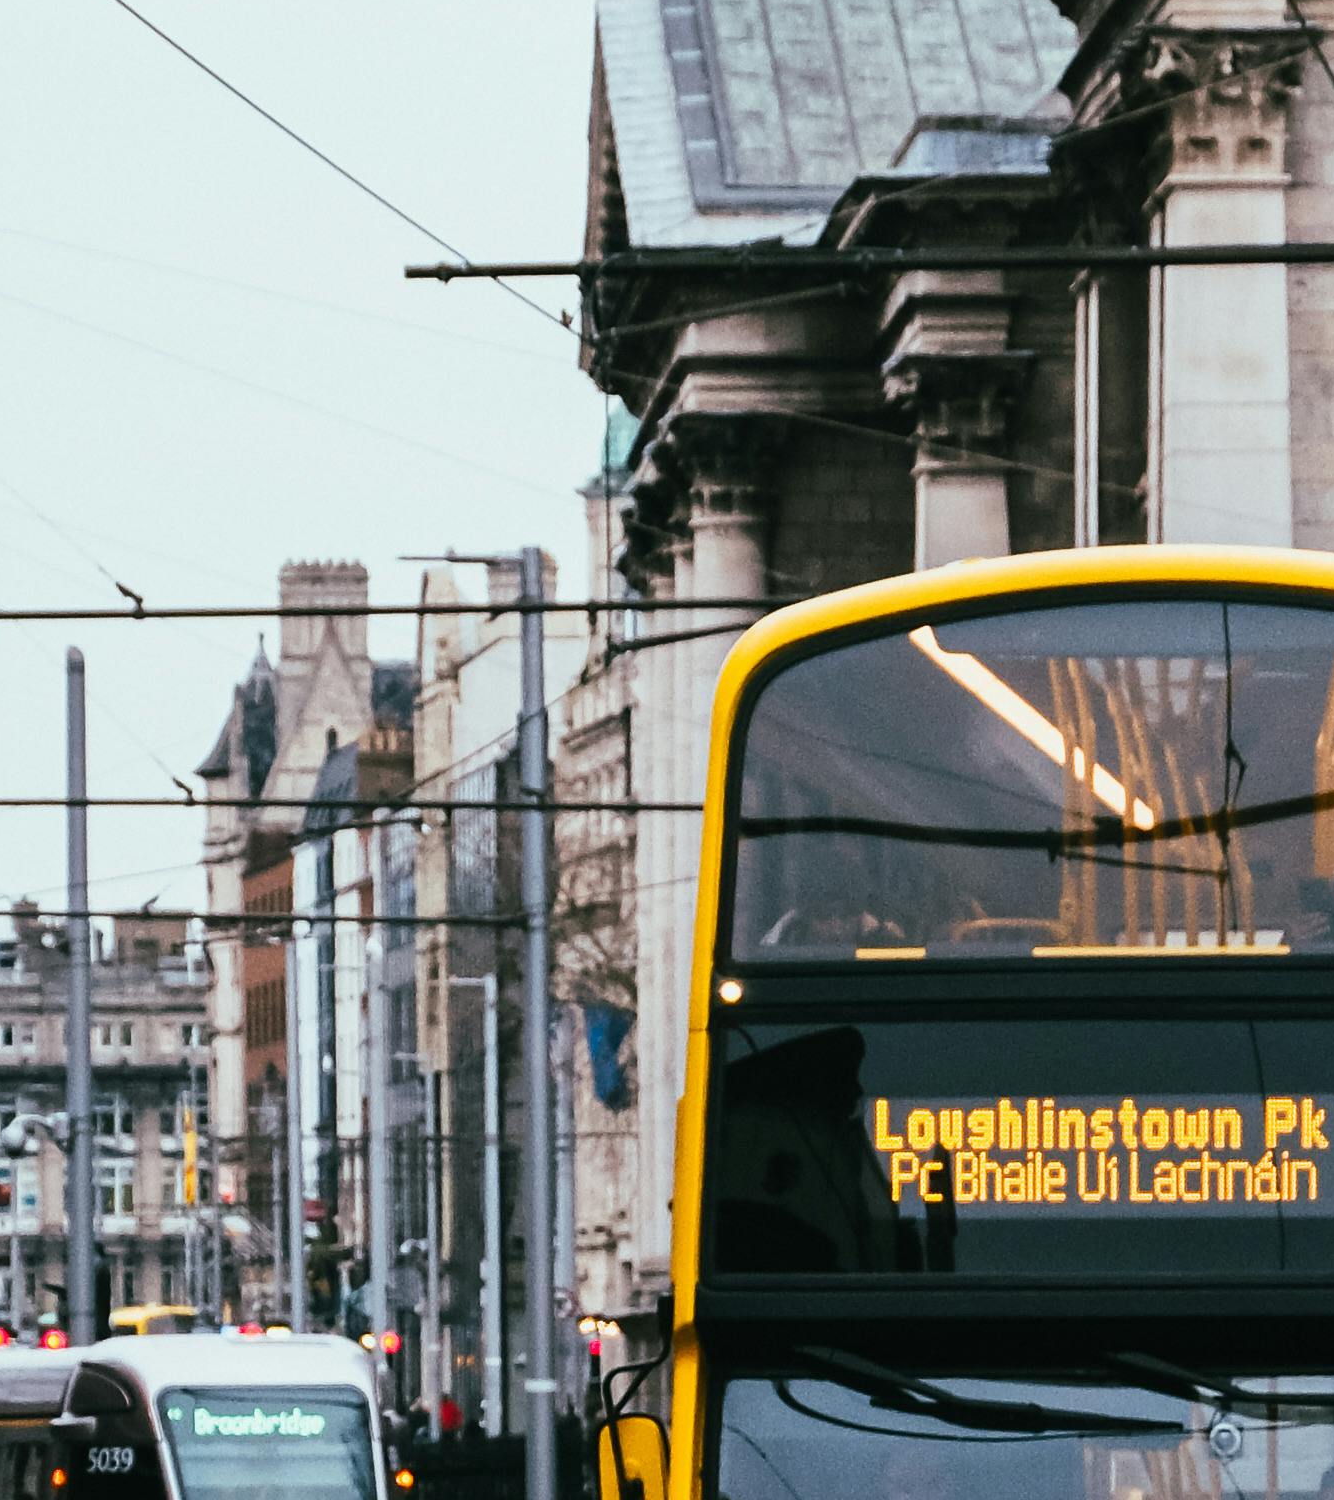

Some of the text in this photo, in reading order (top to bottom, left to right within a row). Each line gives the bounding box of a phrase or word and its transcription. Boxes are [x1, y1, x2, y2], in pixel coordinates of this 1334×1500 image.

[875, 1097, 1329, 1150] Loughlinstown Pk
[890, 1151, 944, 1203] Pc
[954, 1151, 1067, 1203] Bhaile
[1129, 1150, 1317, 1203] Lachnáin
[87, 1447, 135, 1474] 5039
